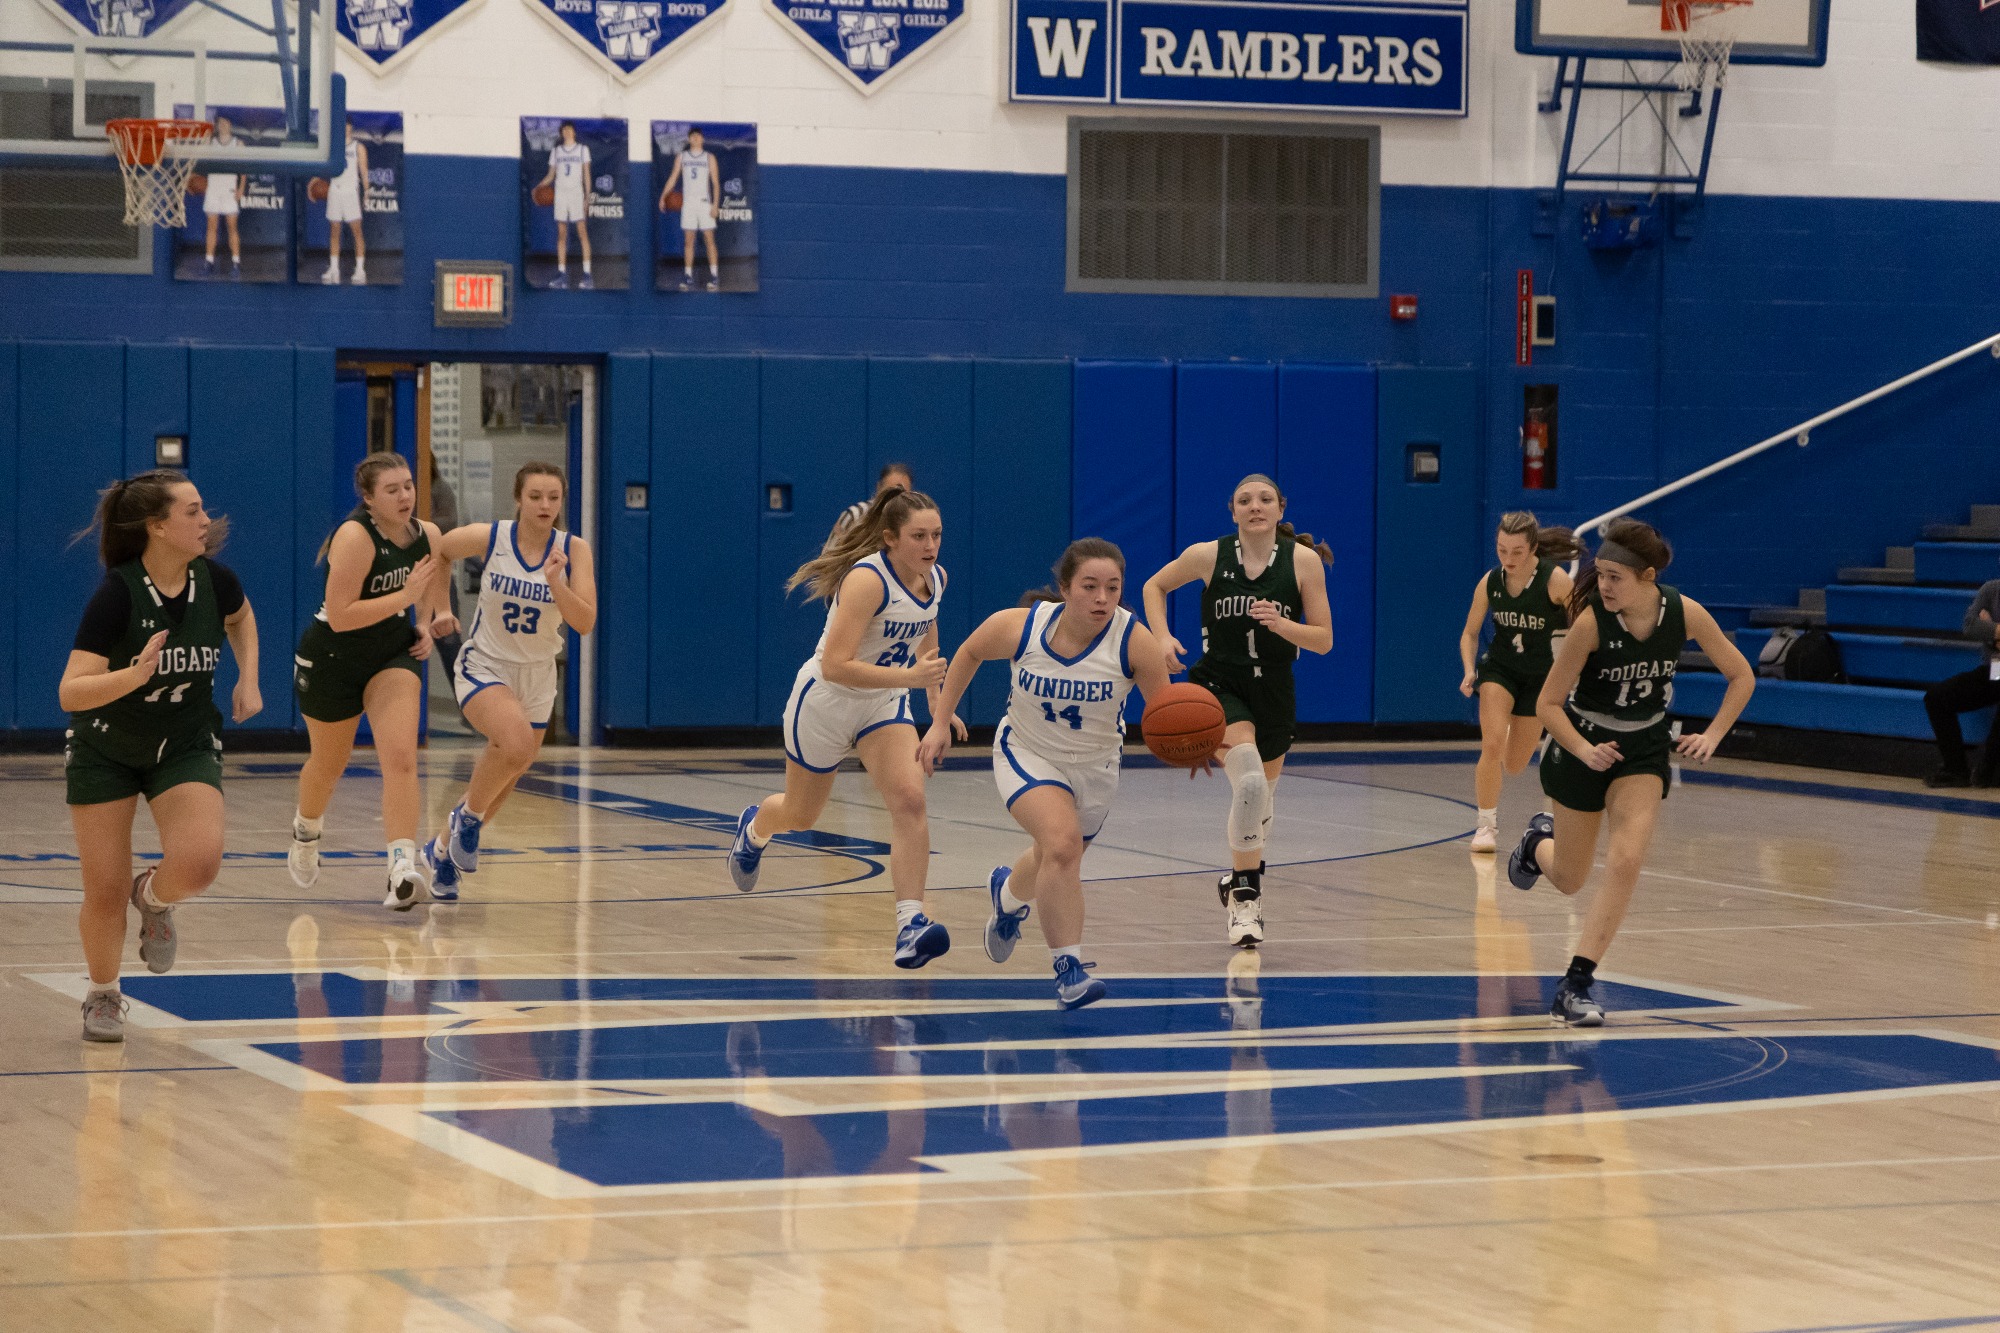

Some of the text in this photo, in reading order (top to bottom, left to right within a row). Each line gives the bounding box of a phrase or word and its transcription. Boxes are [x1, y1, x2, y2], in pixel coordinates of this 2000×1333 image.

[554, 1, 593, 13] BOYS
[668, 3, 707, 16] BOYS
[788, 7, 832, 21] GIRLS
[903, 13, 948, 26] GIRLS
[1027, 17, 1097, 78] W
[1140, 27, 1443, 86] RAMBLERS
[456, 276, 493, 308] EXIT
[370, 567, 410, 593] COUG
[489, 572, 556, 603] WINDBE
[502, 602, 540, 634] 23
[1512, 633, 1524, 653] 4
[1018, 667, 1114, 702] WINDBER
[1041, 701, 1083, 730] 14
